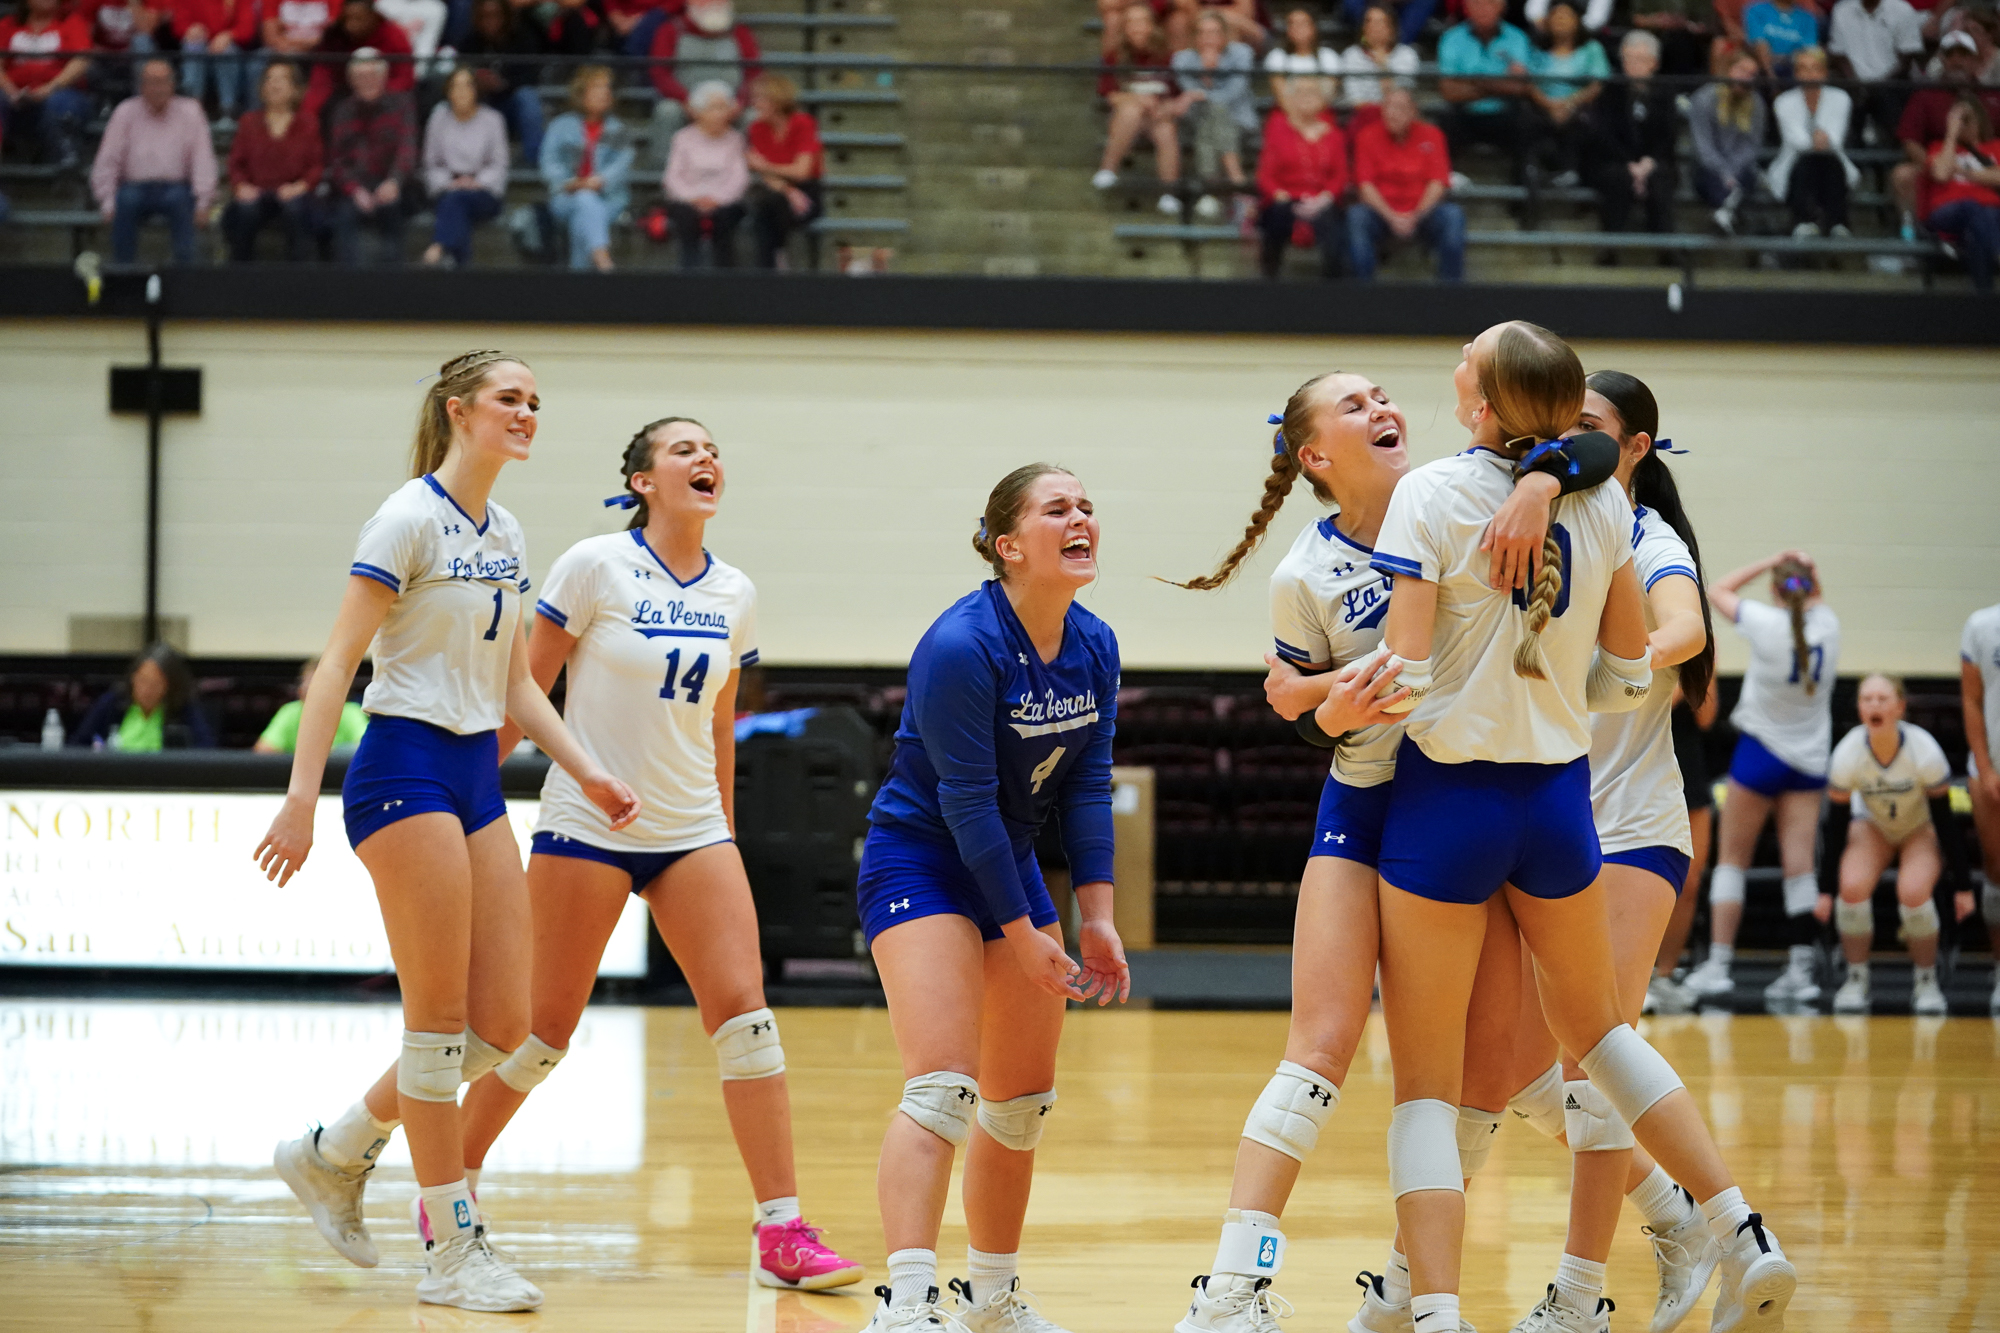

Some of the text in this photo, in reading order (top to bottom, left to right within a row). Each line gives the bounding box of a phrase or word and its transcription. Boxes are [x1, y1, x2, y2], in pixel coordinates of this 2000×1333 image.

[483, 587, 502, 641] 1
[631, 599, 729, 629] La Vernia
[1342, 587, 1382, 624] La
[659, 647, 710, 704] 14
[1010, 690, 1045, 722] La
[1030, 746, 1066, 795] 4
[6, 800, 221, 843] NORTH
[1, 911, 374, 959] San Antonio
